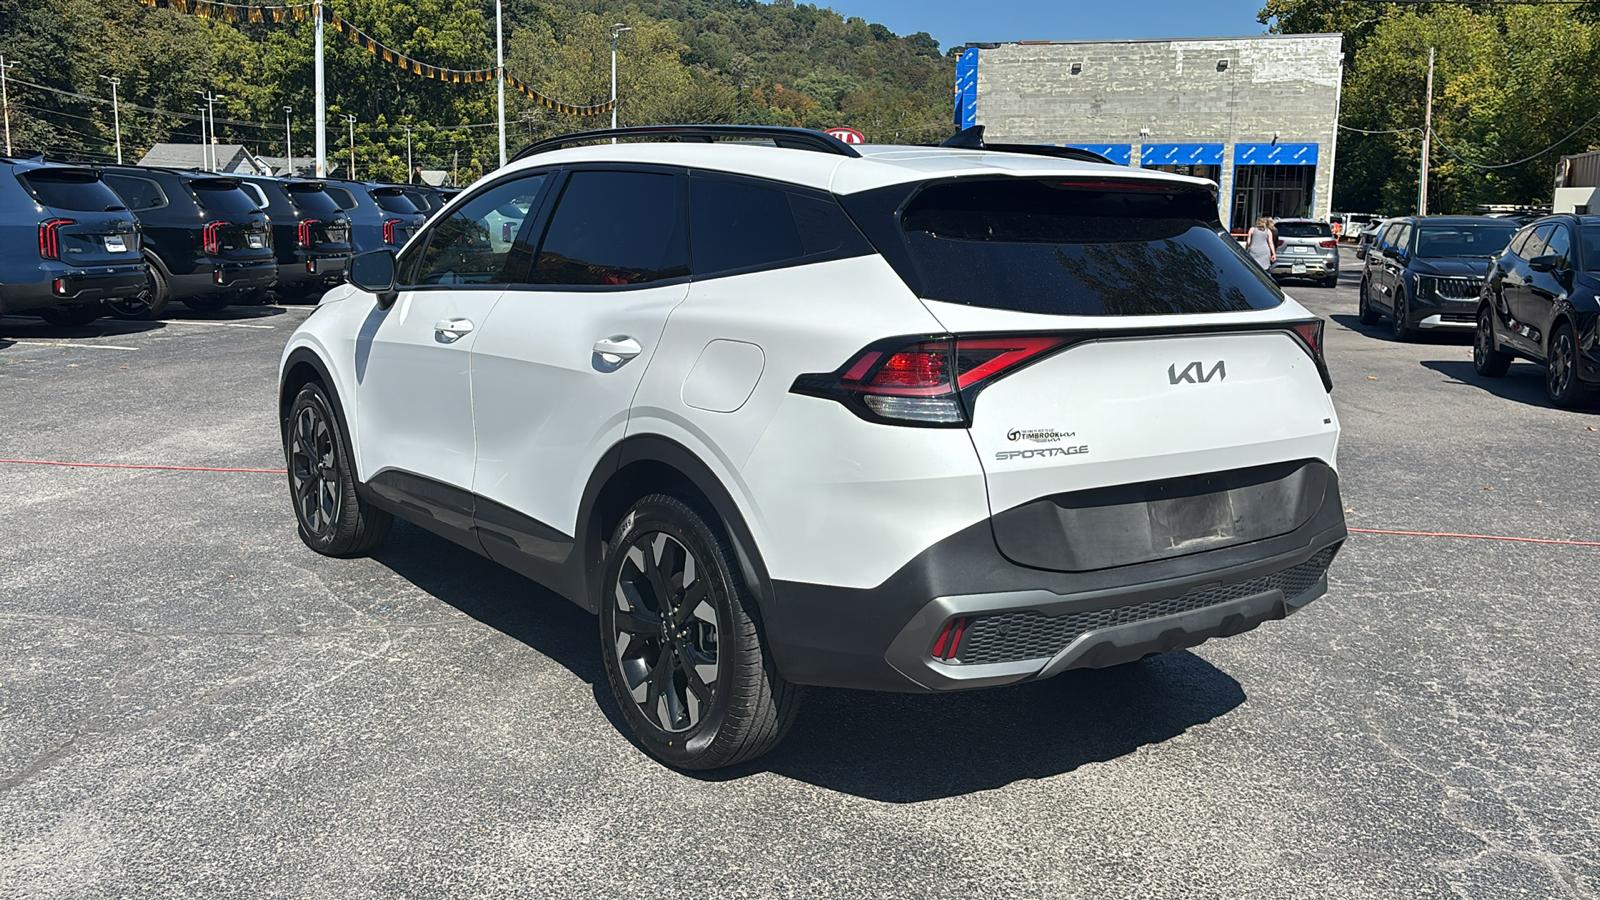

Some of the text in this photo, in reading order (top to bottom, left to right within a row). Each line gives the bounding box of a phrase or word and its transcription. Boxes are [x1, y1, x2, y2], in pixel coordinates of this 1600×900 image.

[1168, 360, 1226, 385] KIA
[1021, 431, 1060, 440] TIMBROOK
[995, 445, 1090, 461] SPORTAGE
